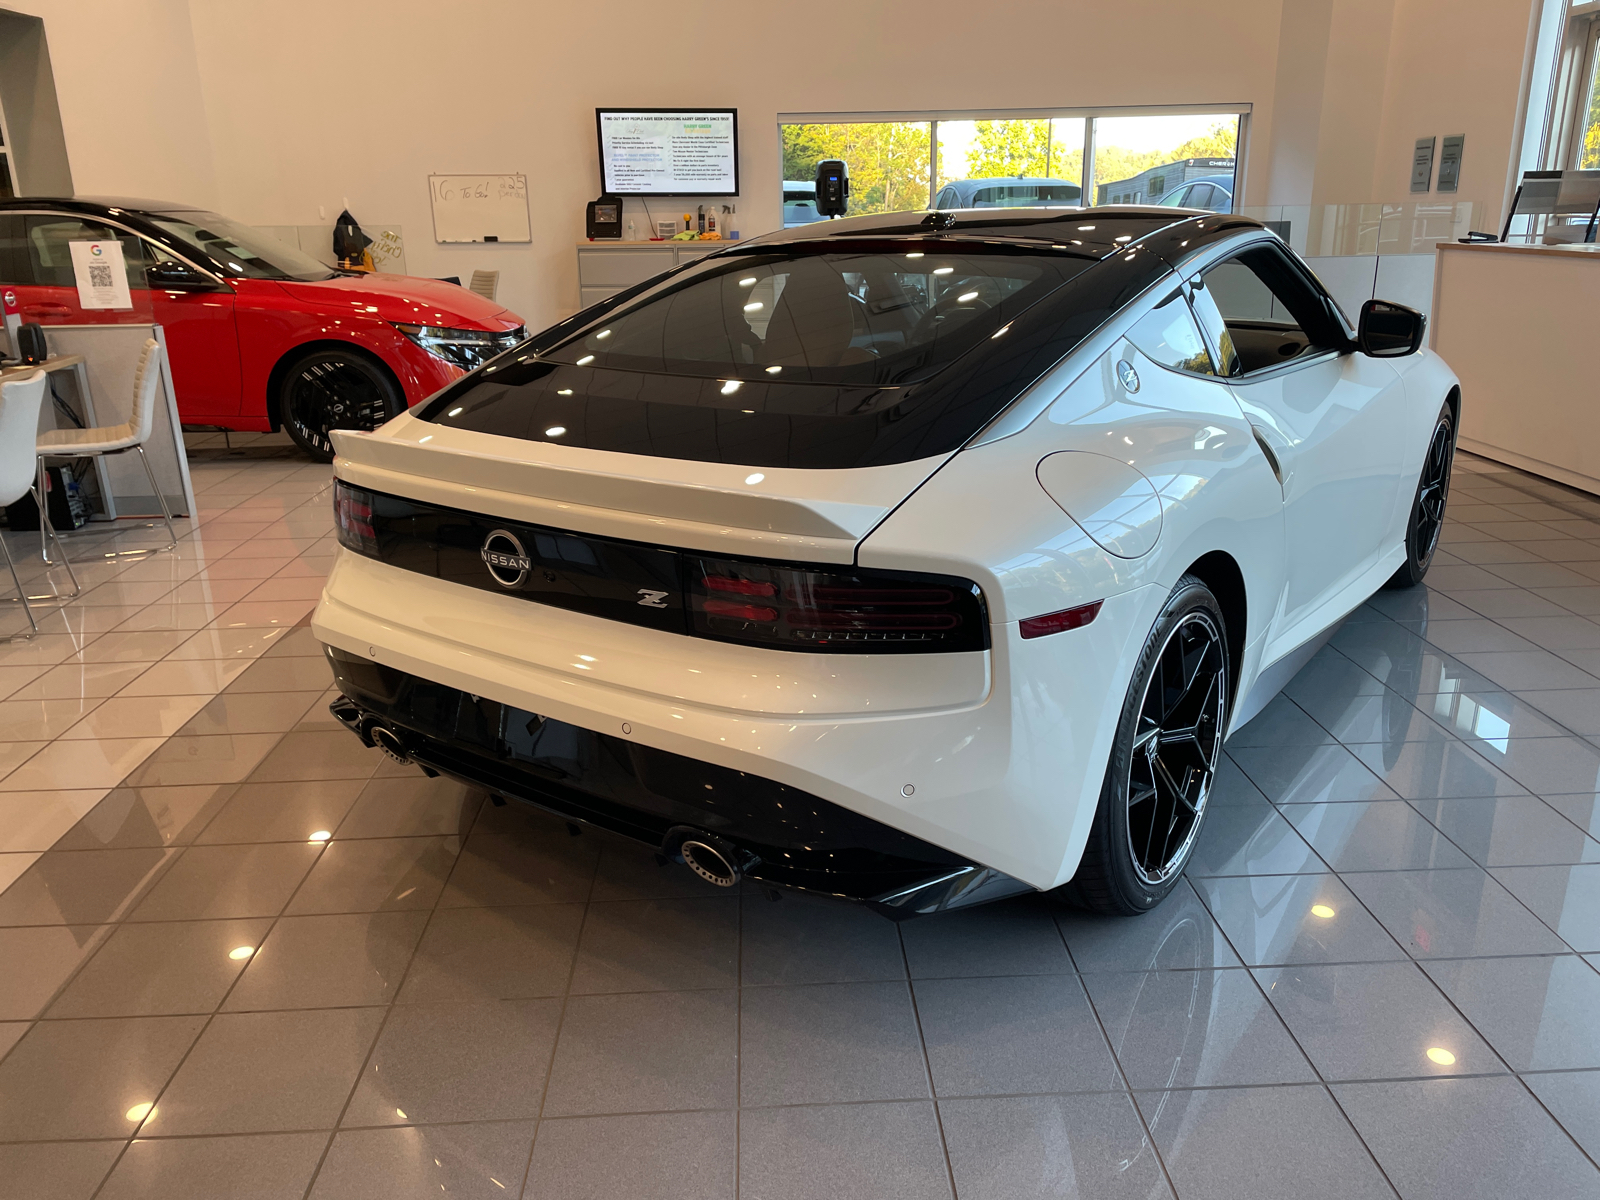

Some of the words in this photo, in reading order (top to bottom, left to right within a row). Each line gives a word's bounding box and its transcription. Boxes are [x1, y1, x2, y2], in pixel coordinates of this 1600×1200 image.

[460, 186, 472, 199] To
[481, 550, 530, 569] NISSAN
[636, 588, 669, 609] Z
[1114, 624, 1163, 769] BRIDGESTONE
